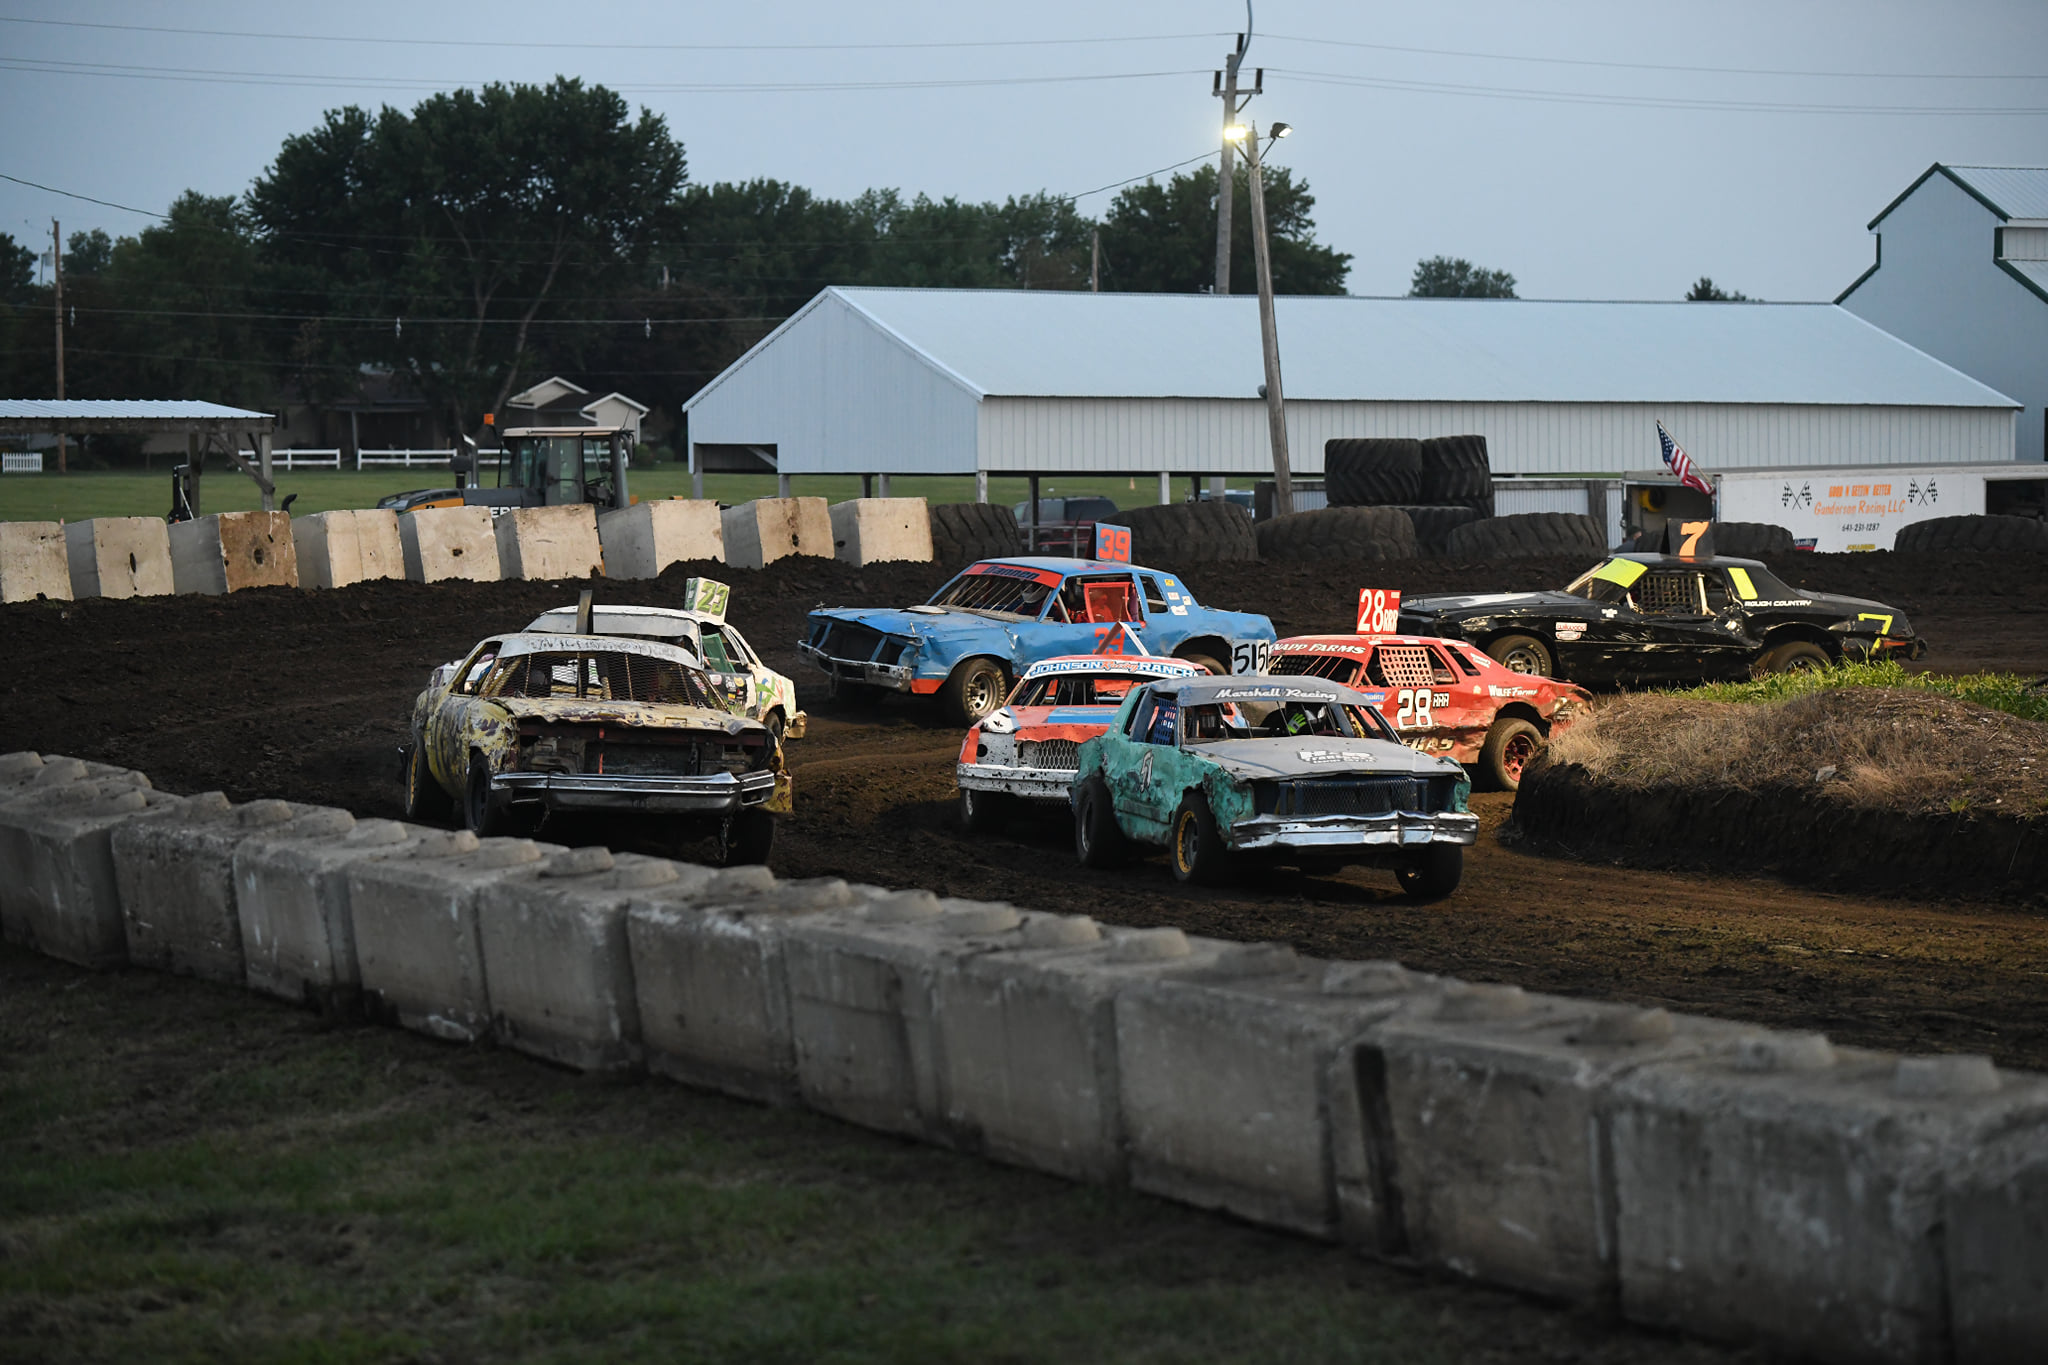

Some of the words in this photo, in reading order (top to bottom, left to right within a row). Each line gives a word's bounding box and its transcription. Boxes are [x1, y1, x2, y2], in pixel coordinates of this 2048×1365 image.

[1828, 485, 1843, 498] GOOD
[1873, 483, 1891, 496] BETTER
[1814, 501, 1857, 516] Gunderson
[1858, 499, 1886, 518] Racing
[1888, 499, 1906, 513] LLC
[1841, 522, 1880, 532] 641-231-1287
[1098, 528, 1130, 562] 39
[1678, 521, 1709, 556] 7
[696, 581, 729, 616] 23
[1773, 599, 1812, 607] COUNTRY
[1857, 612, 1893, 656] 7
[1258, 642, 1269, 673] 51
[1308, 643, 1367, 654] FARMS
[1234, 643, 1257, 674] 51
[1031, 662, 1101, 675] JOHNSON
[1100, 660, 1139, 672] Racing
[1138, 662, 1196, 677] RANCH
[1213, 687, 1281, 699] Marshall
[1282, 688, 1338, 702] Racing
